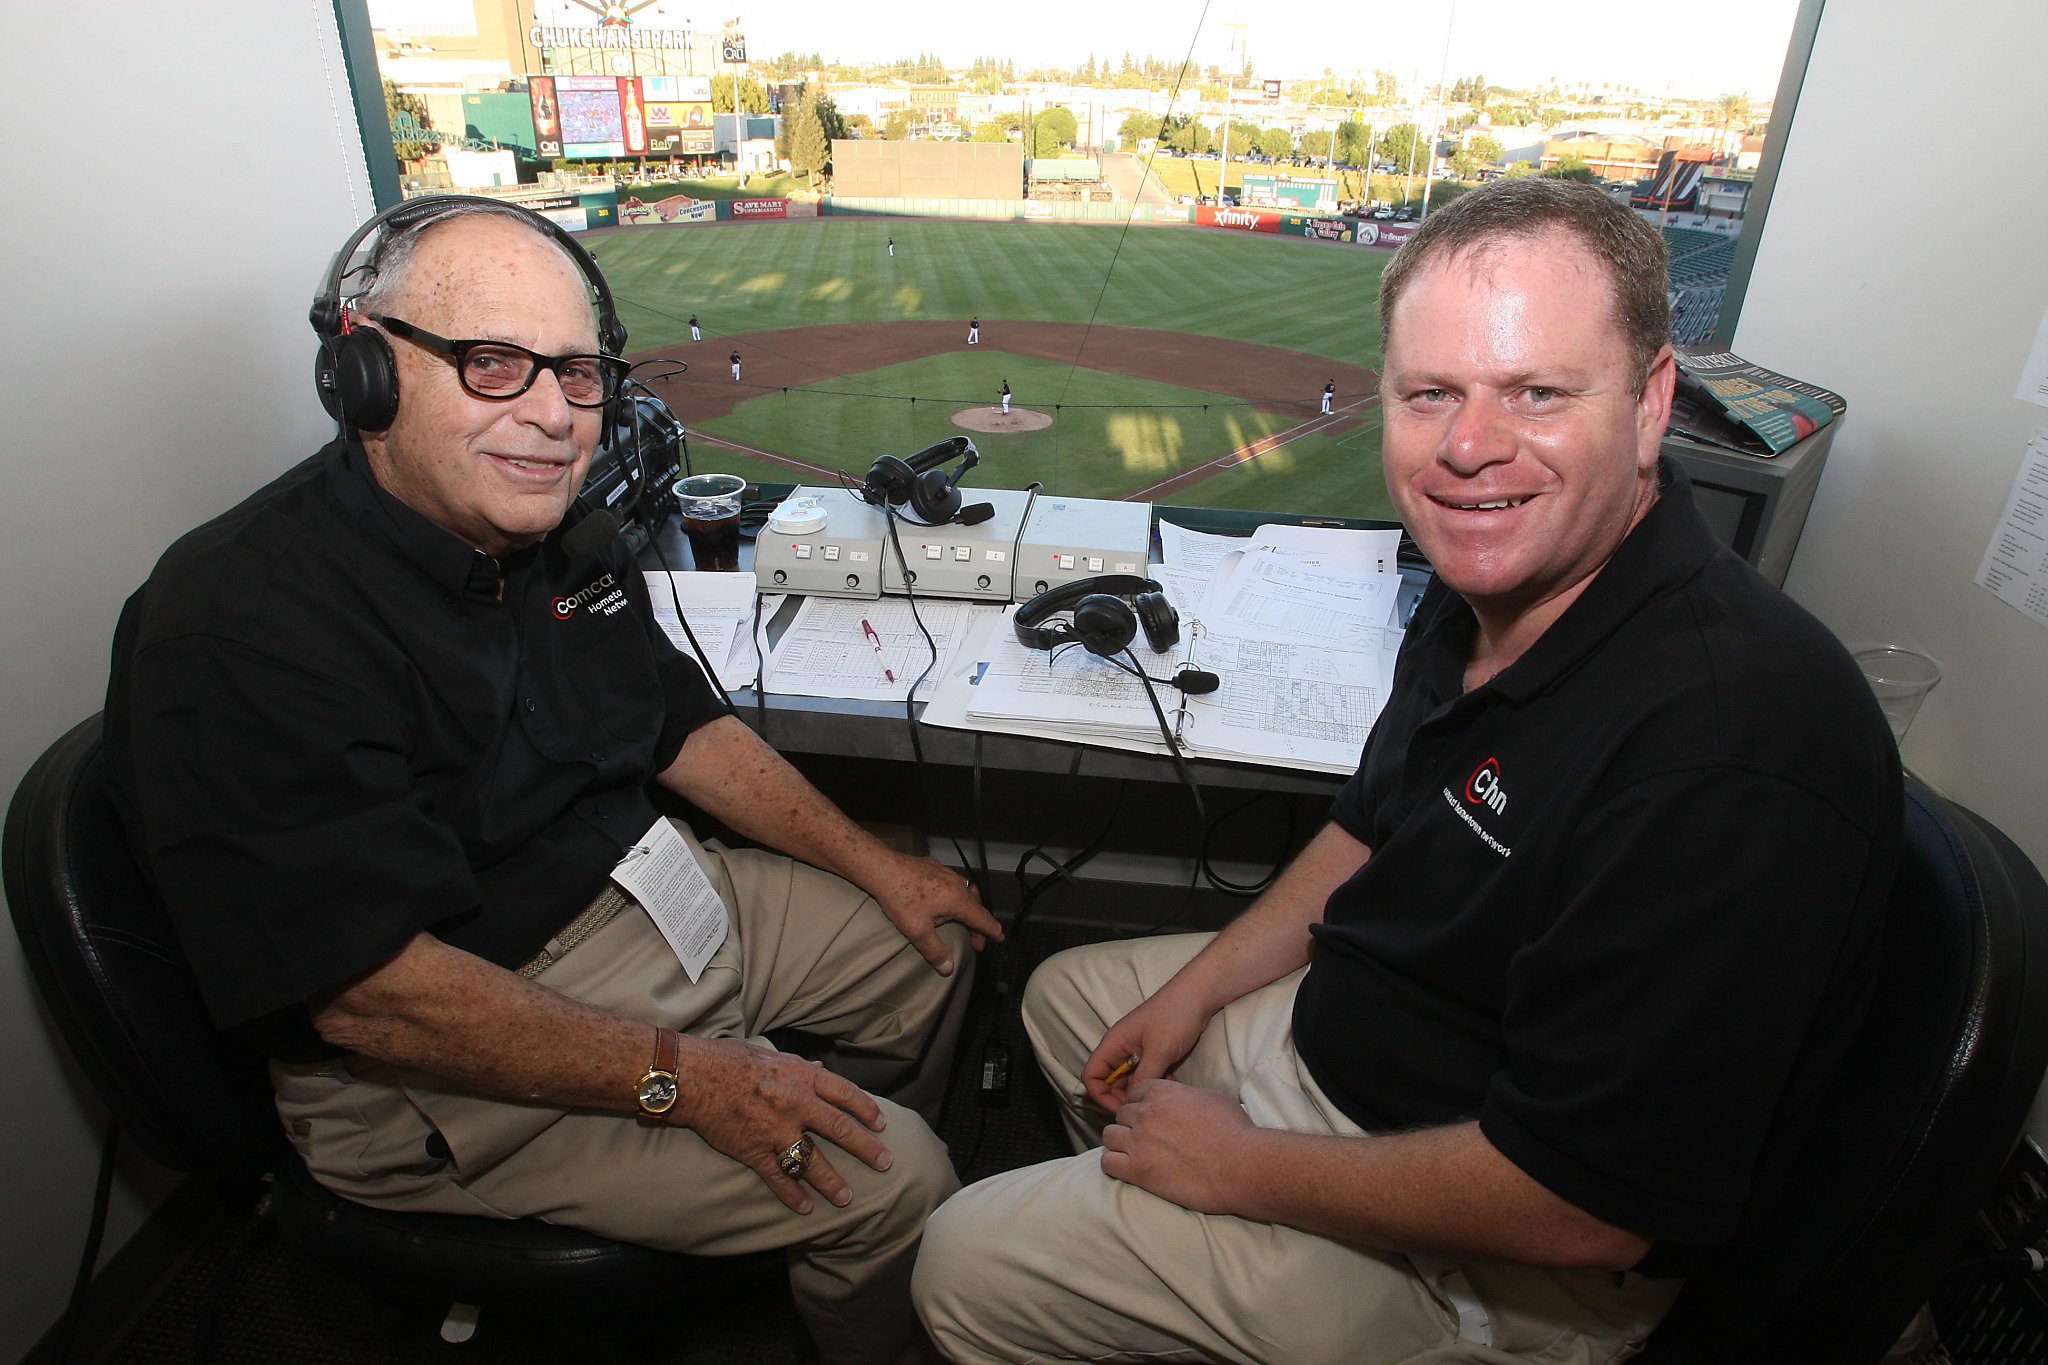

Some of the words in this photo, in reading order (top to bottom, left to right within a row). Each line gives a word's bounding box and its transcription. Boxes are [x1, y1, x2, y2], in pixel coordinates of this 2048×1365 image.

[529, 27, 650, 49] CHUKCHANSI
[650, 29, 697, 50] PARK
[650, 139, 673, 151] Rely
[1214, 208, 1260, 230] xfinity
[1470, 763, 1507, 816] Chn
[1480, 830, 1511, 857] network
